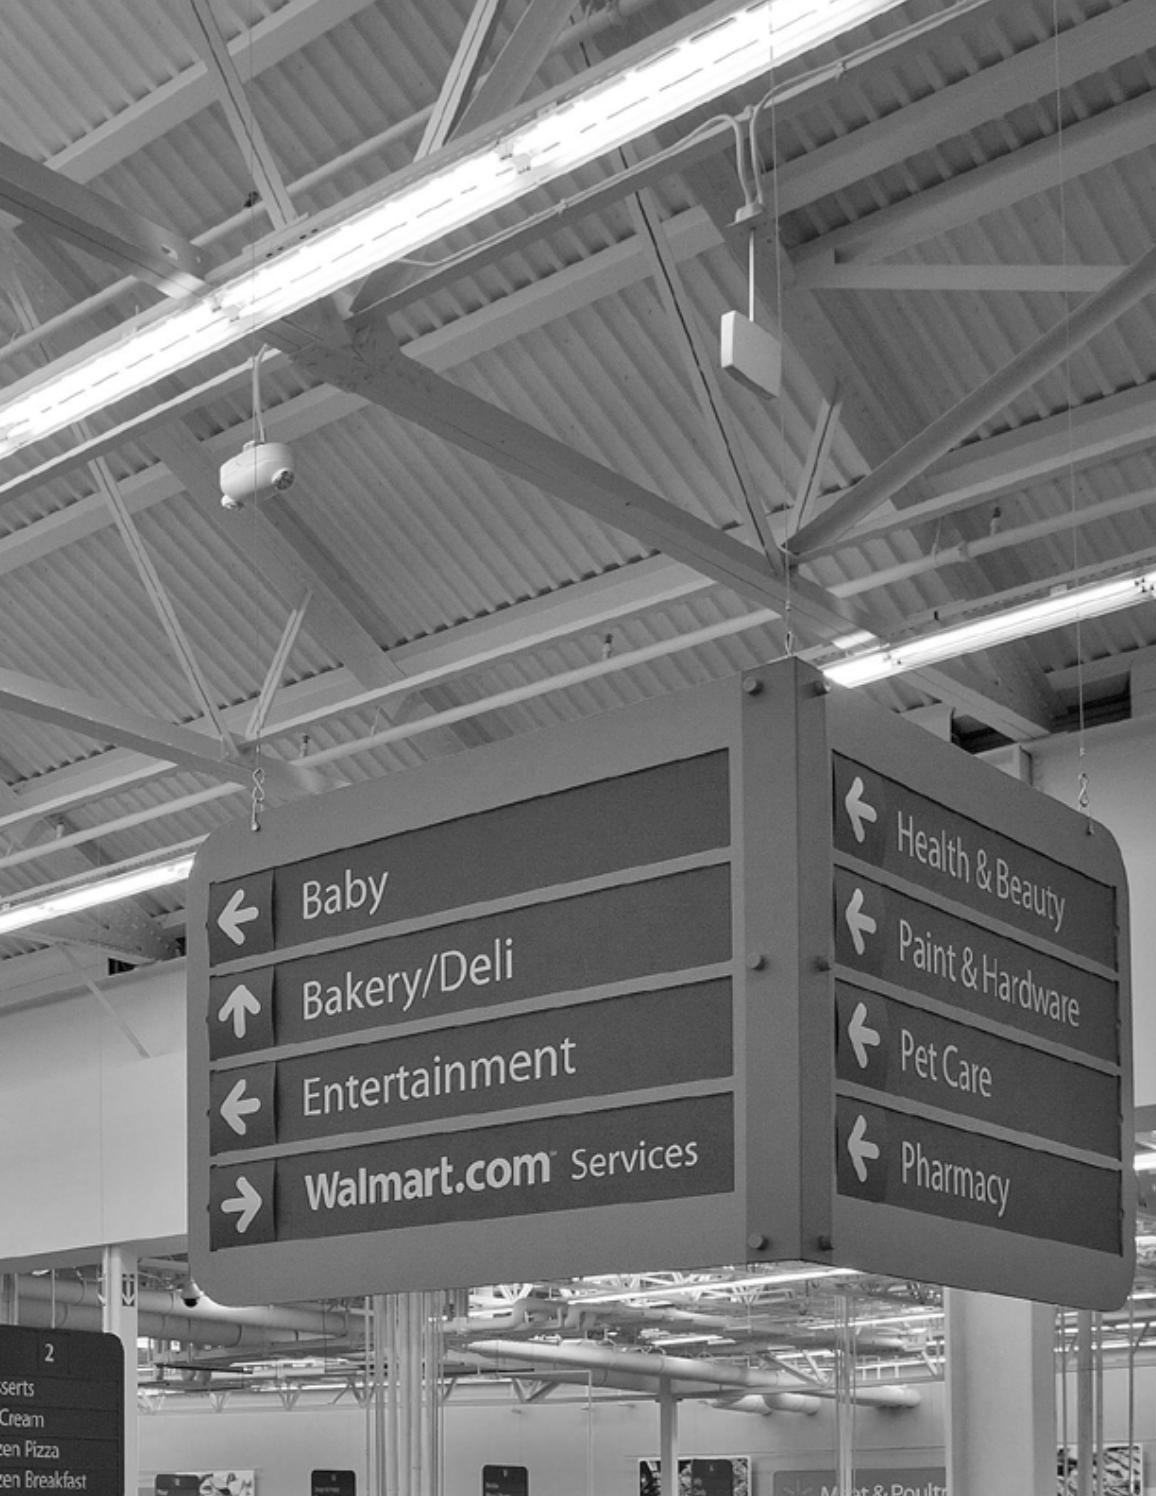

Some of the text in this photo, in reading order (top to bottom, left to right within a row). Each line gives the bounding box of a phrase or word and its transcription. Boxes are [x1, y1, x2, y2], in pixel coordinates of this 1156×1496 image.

[302, 868, 389, 920] Baby
[897, 810, 1066, 934] Health & Beauty
[302, 937, 514, 1021] Bakery/Deli
[899, 918, 1081, 1028] Paint & Hardware
[302, 1036, 578, 1117] Entertainment
[901, 1028, 993, 1098] Pet Care
[304, 1140, 699, 1211] Walmart.com Services
[901, 1140, 1011, 1218] Pharmacy
[44, 1343, 55, 1363] 2
[0, 1407, 45, 1429] Cream
[25, 1439, 60, 1459] Pizza
[25, 1469, 88, 1491] Breakfast
